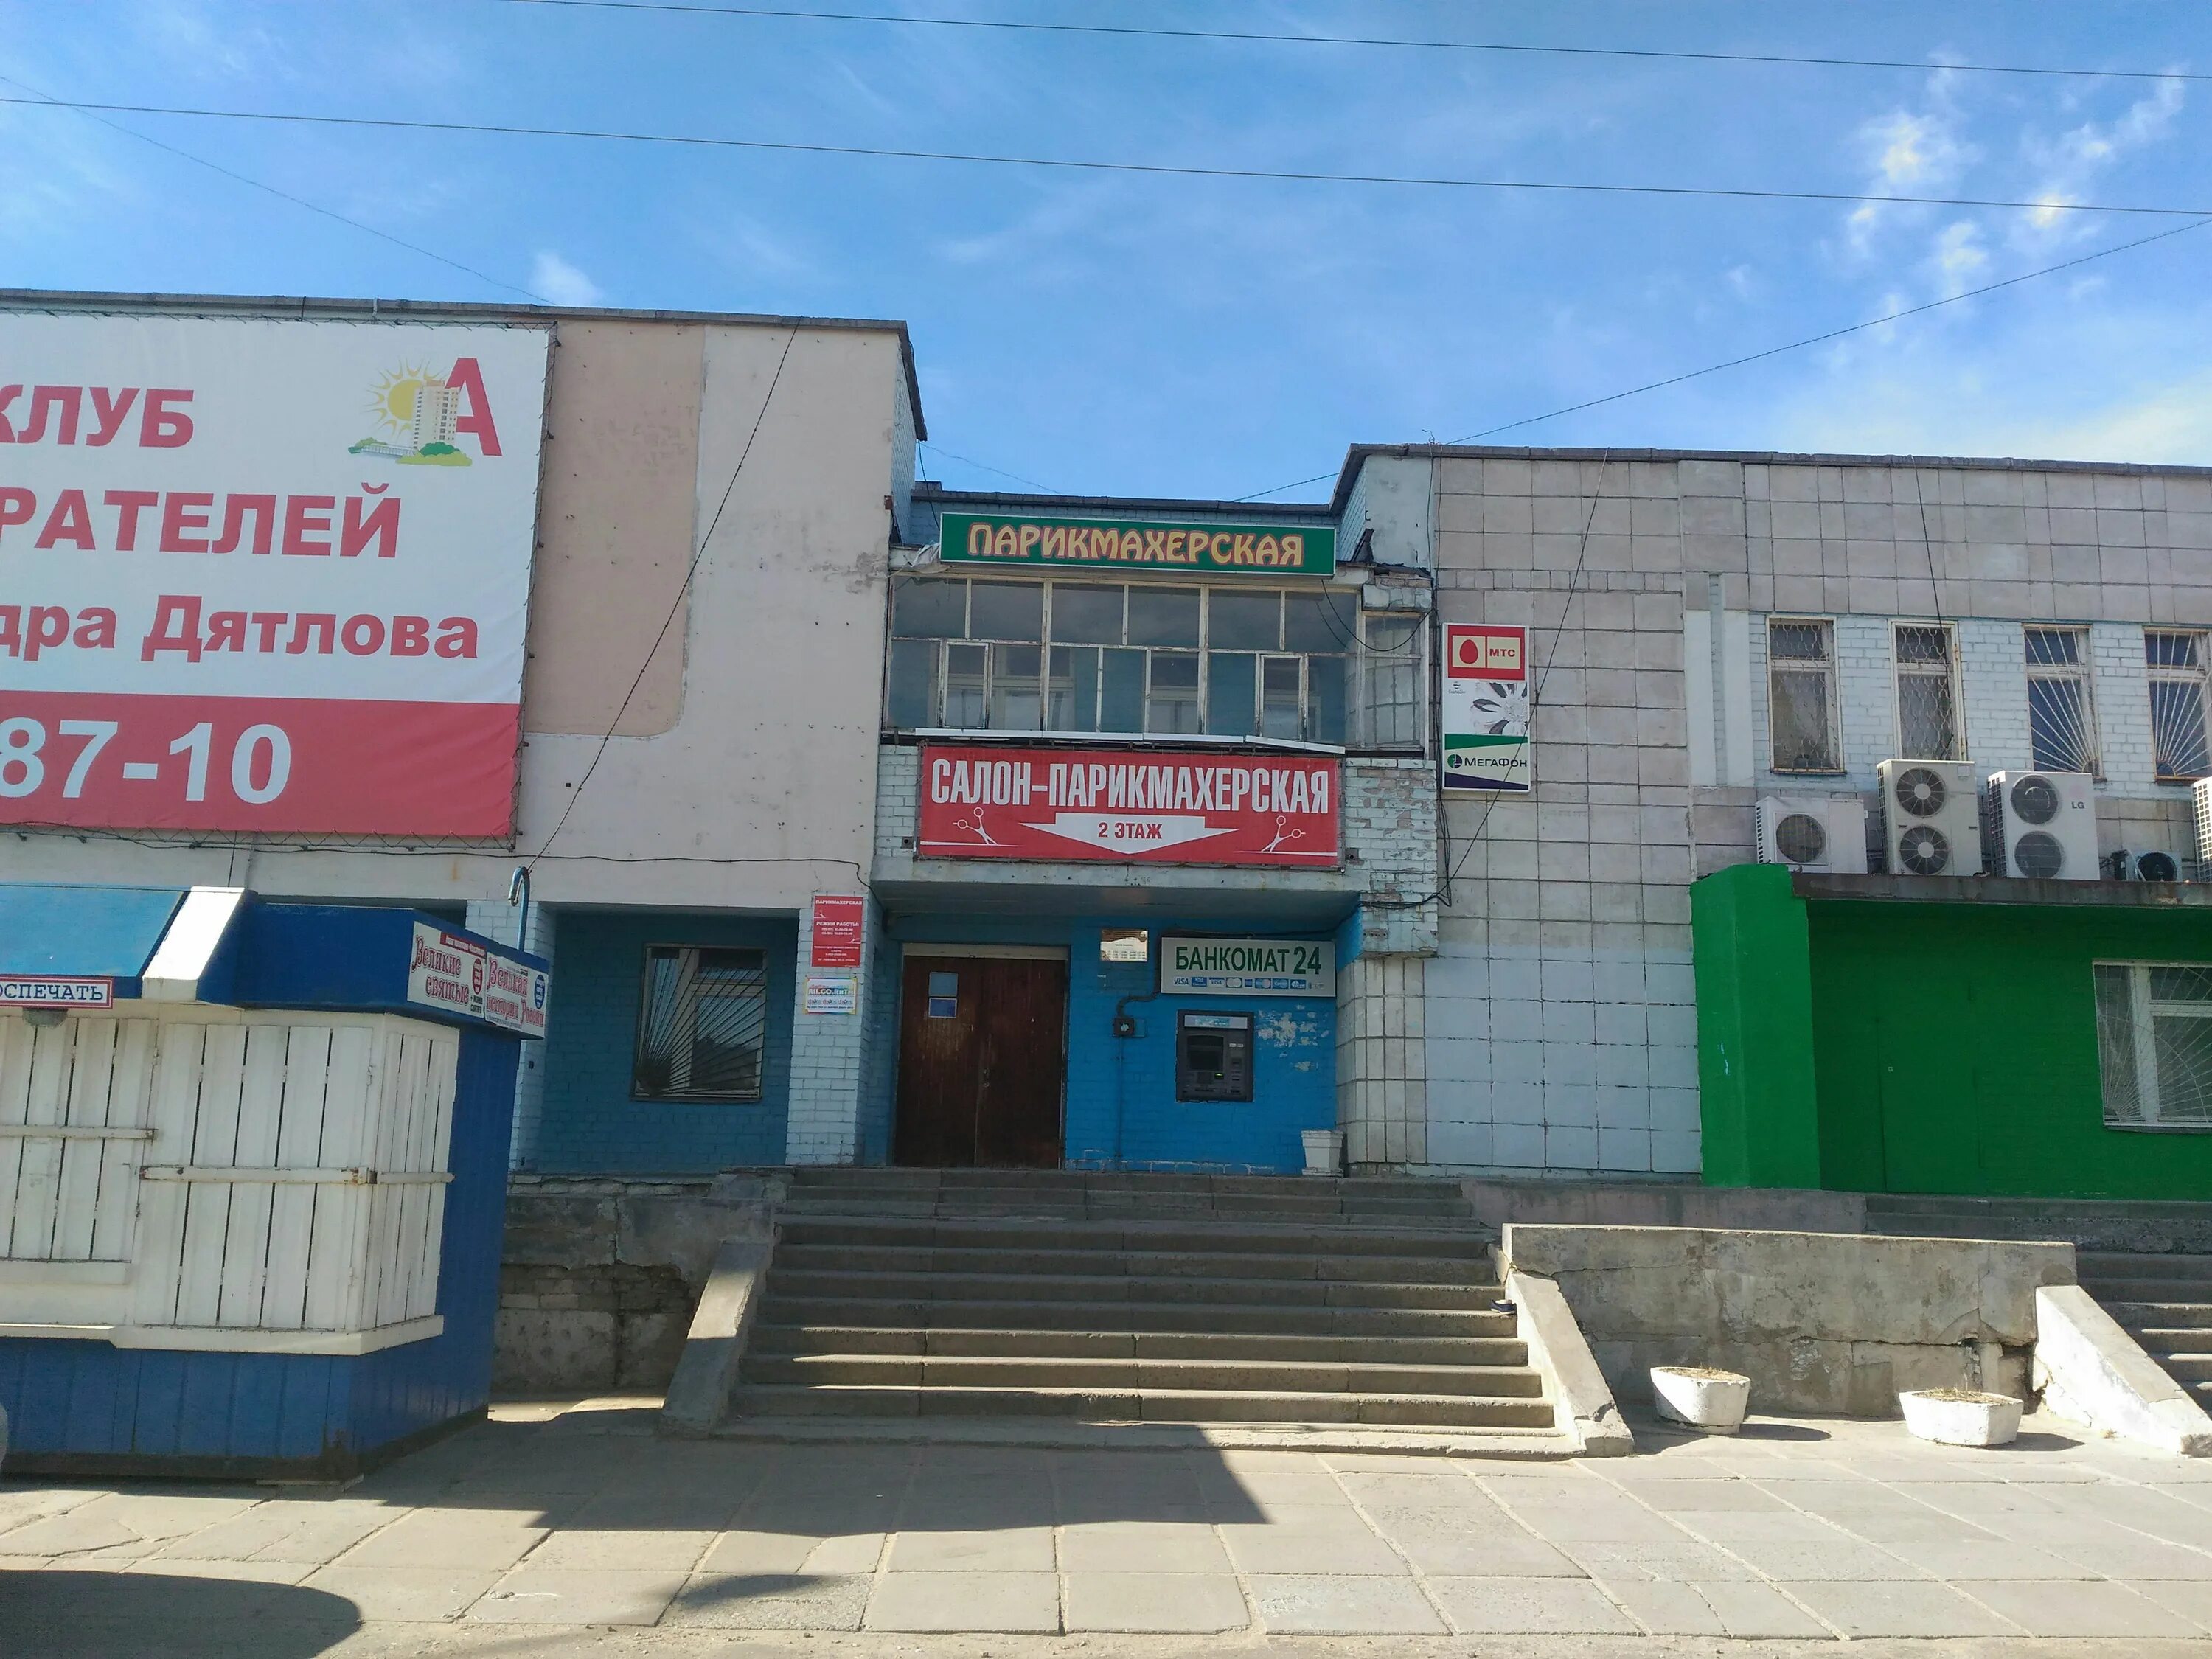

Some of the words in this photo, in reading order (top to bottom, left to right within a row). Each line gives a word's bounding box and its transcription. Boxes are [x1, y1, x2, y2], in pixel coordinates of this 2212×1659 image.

[0, 483, 401, 558] РАТЕЛЕЙ
[967, 522, 1304, 567] ПАРИКМАХЕРСКАЯ
[141, 595, 478, 663] Дятлова
[1489, 648, 1515, 658] МТС
[0, 717, 291, 804] 87-10
[931, 758, 1329, 814] САЛОН-ПАРИКМАХЕРСКАЯ
[1097, 822, 1109, 838] 2
[1113, 821, 1163, 839] ЭТАЖ
[411, 935, 462, 976] Великие
[1175, 946, 1290, 973] БАНКОМАТ
[1293, 946, 1322, 975] 24
[0, 984, 103, 1000] СПЕЧАТЬ
